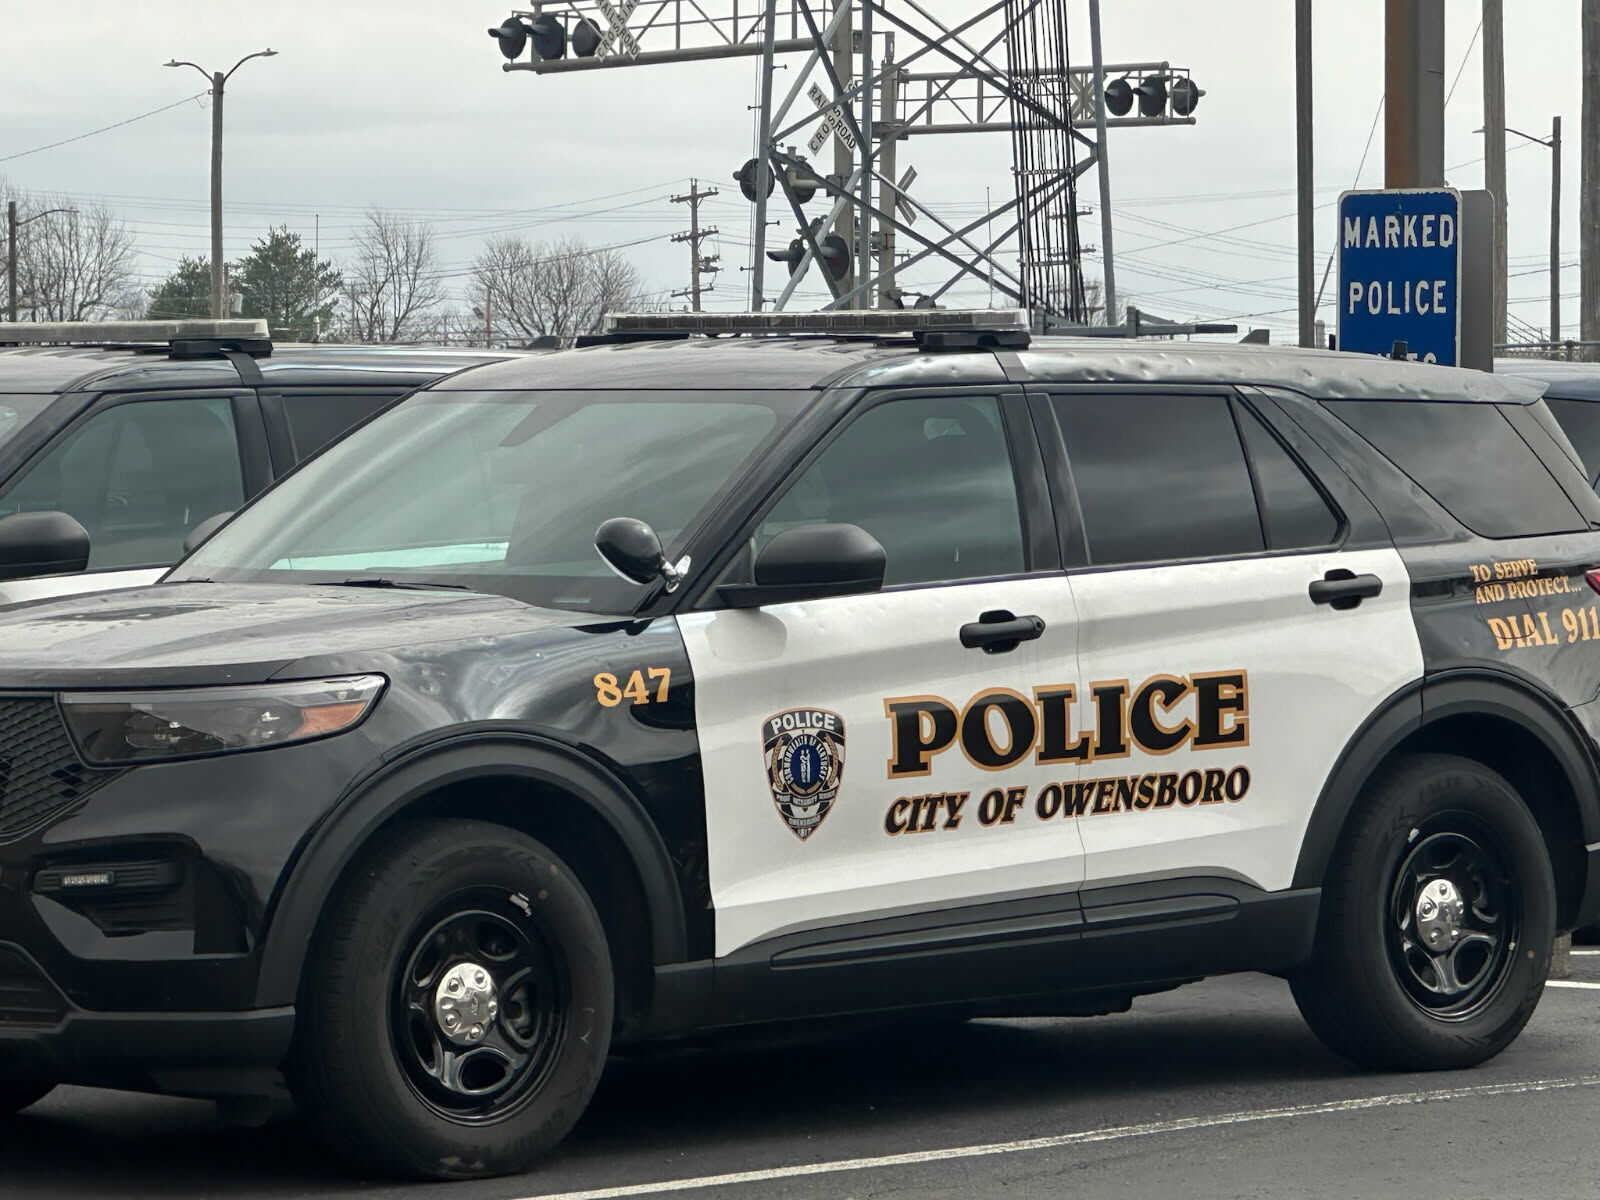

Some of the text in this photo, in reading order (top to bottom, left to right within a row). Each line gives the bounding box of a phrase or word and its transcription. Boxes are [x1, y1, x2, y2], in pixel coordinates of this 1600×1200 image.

[1344, 214, 1454, 248] MARKED
[1349, 280, 1447, 315] POLICE
[1469, 559, 1538, 582] TO SERVE
[1475, 576, 1581, 604] AND PROTECT...
[1488, 606, 1600, 650] DIAL 911
[593, 667, 671, 707] 847
[770, 711, 835, 734] POLICE
[883, 669, 1250, 779] POLICE
[884, 764, 1251, 836] CITY OF OWENSBORO
